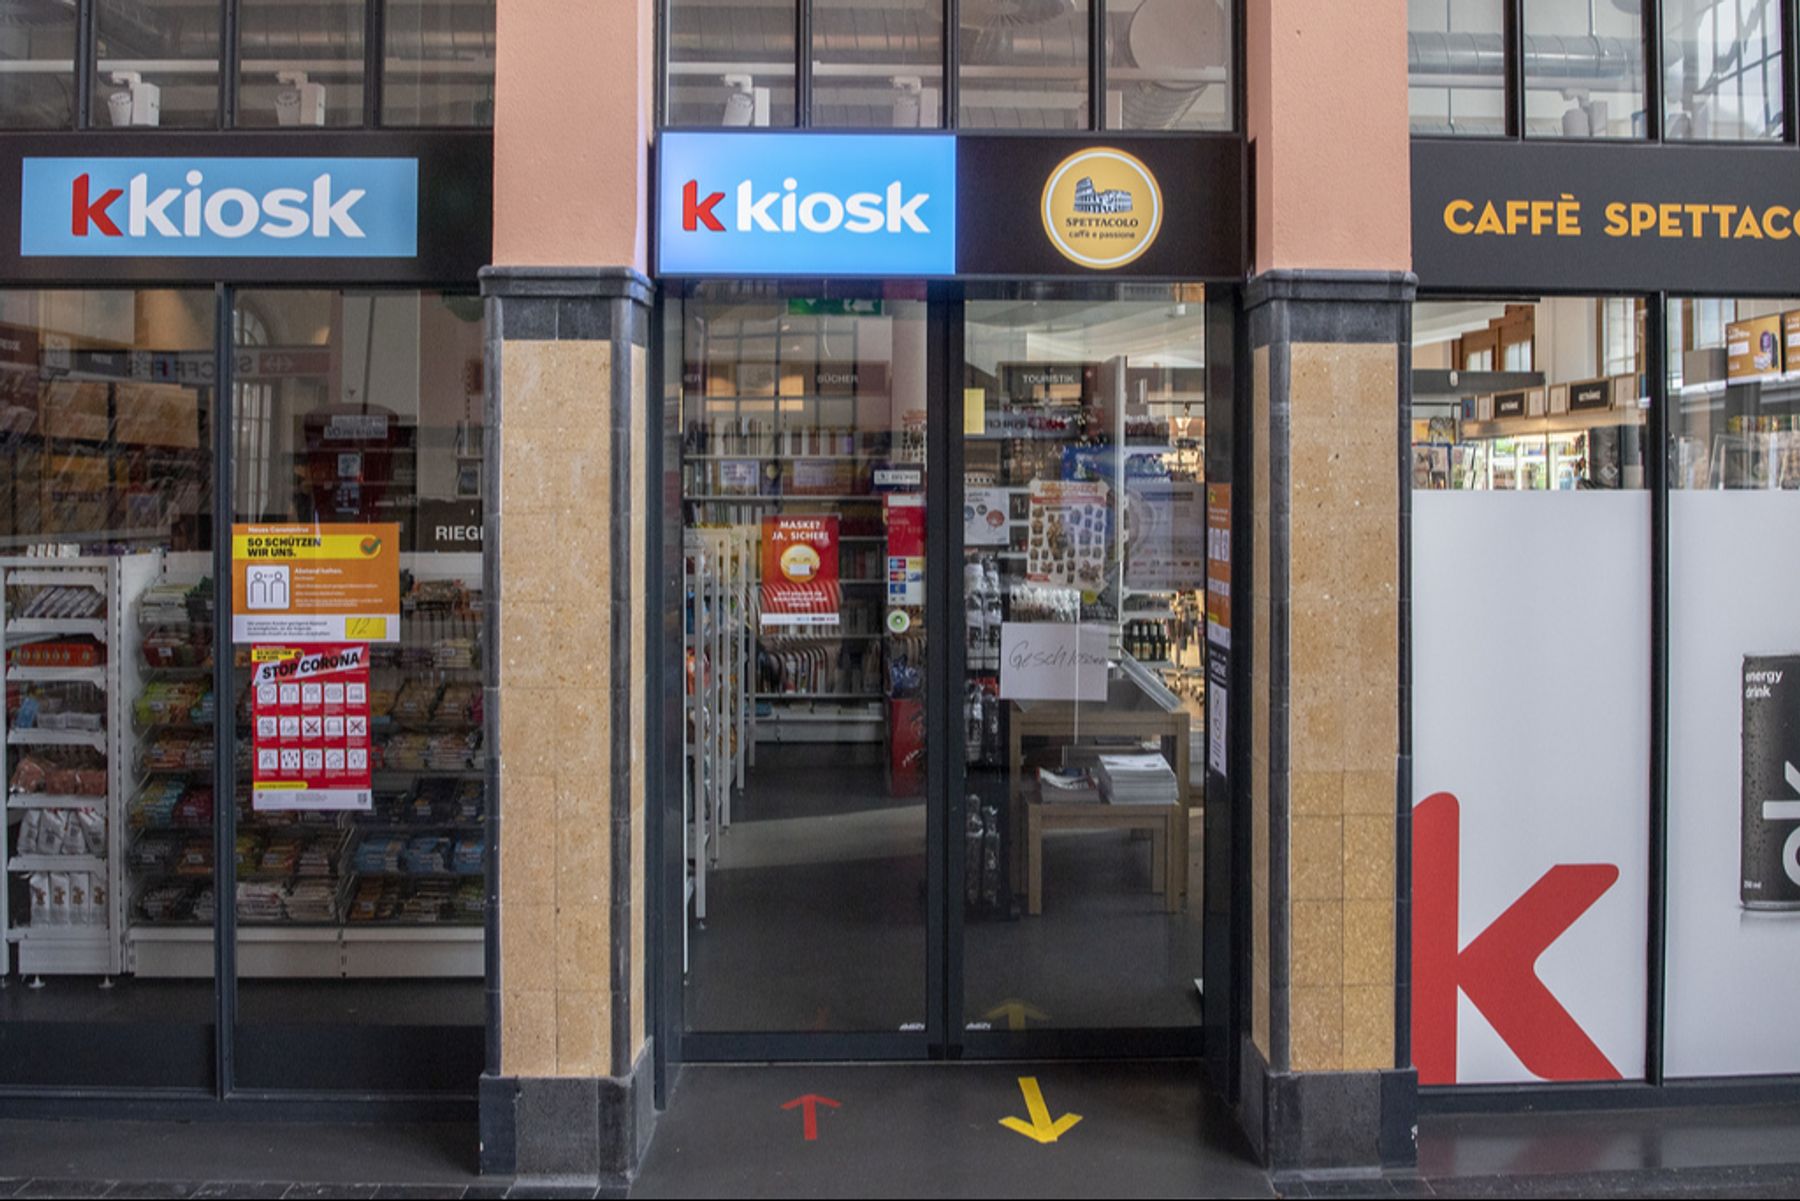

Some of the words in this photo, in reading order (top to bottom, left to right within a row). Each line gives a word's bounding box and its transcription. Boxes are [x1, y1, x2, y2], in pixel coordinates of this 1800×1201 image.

[736, 177, 931, 233] kiosk
[1065, 217, 1139, 228] SPETTACOLO
[1443, 193, 1582, 236] CAFFÈ
[1604, 202, 1800, 241] SPETTAC
[1099, 230, 1136, 240] passione
[1022, 374, 1075, 385] TOURISTIK
[435, 524, 484, 541] RIEG
[248, 537, 263, 547] SO
[265, 535, 321, 547] SCHÜTZEN
[248, 548, 268, 557] WIR
[271, 548, 297, 557] UNS.
[262, 663, 298, 679] STOP
[300, 652, 360, 673] CORONA
